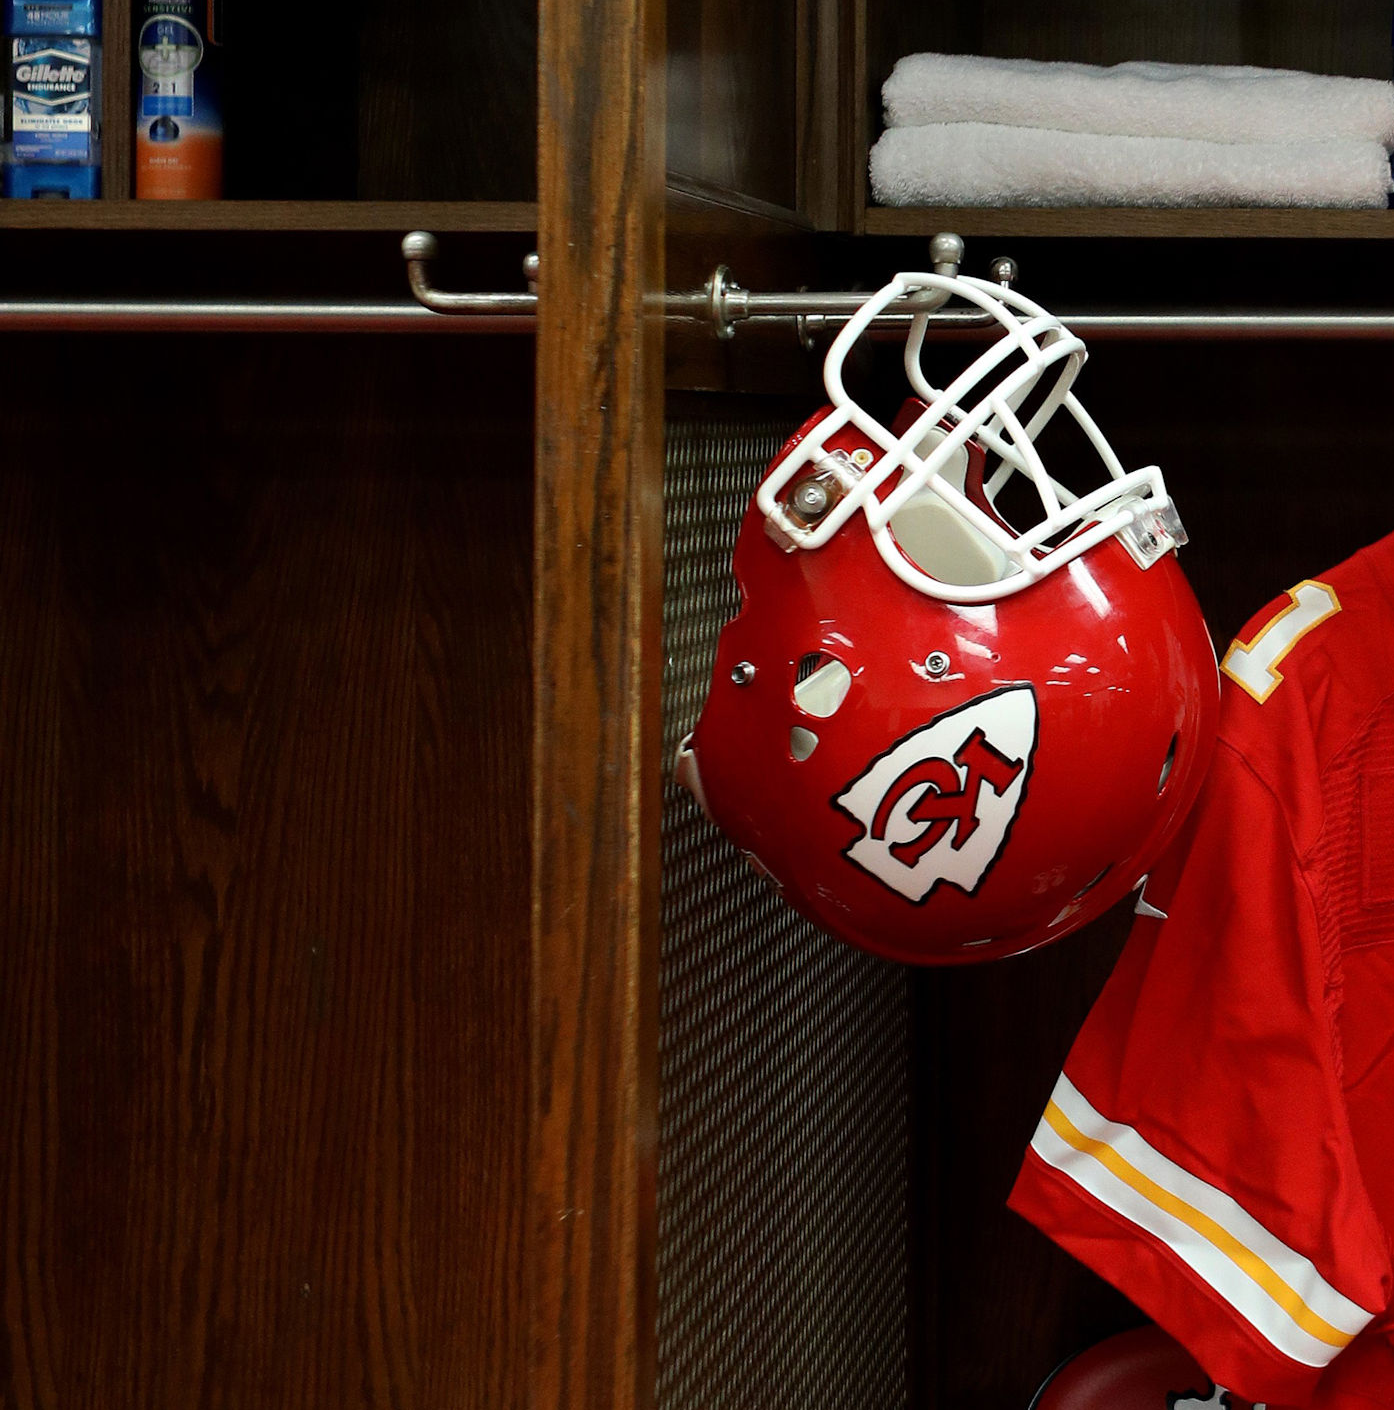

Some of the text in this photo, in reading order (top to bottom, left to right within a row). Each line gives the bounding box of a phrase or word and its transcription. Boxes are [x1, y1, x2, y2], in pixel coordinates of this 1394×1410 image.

[16, 64, 87, 83] Gillette
[1218, 579, 1342, 705] 1
[871, 726, 1025, 869] KC
